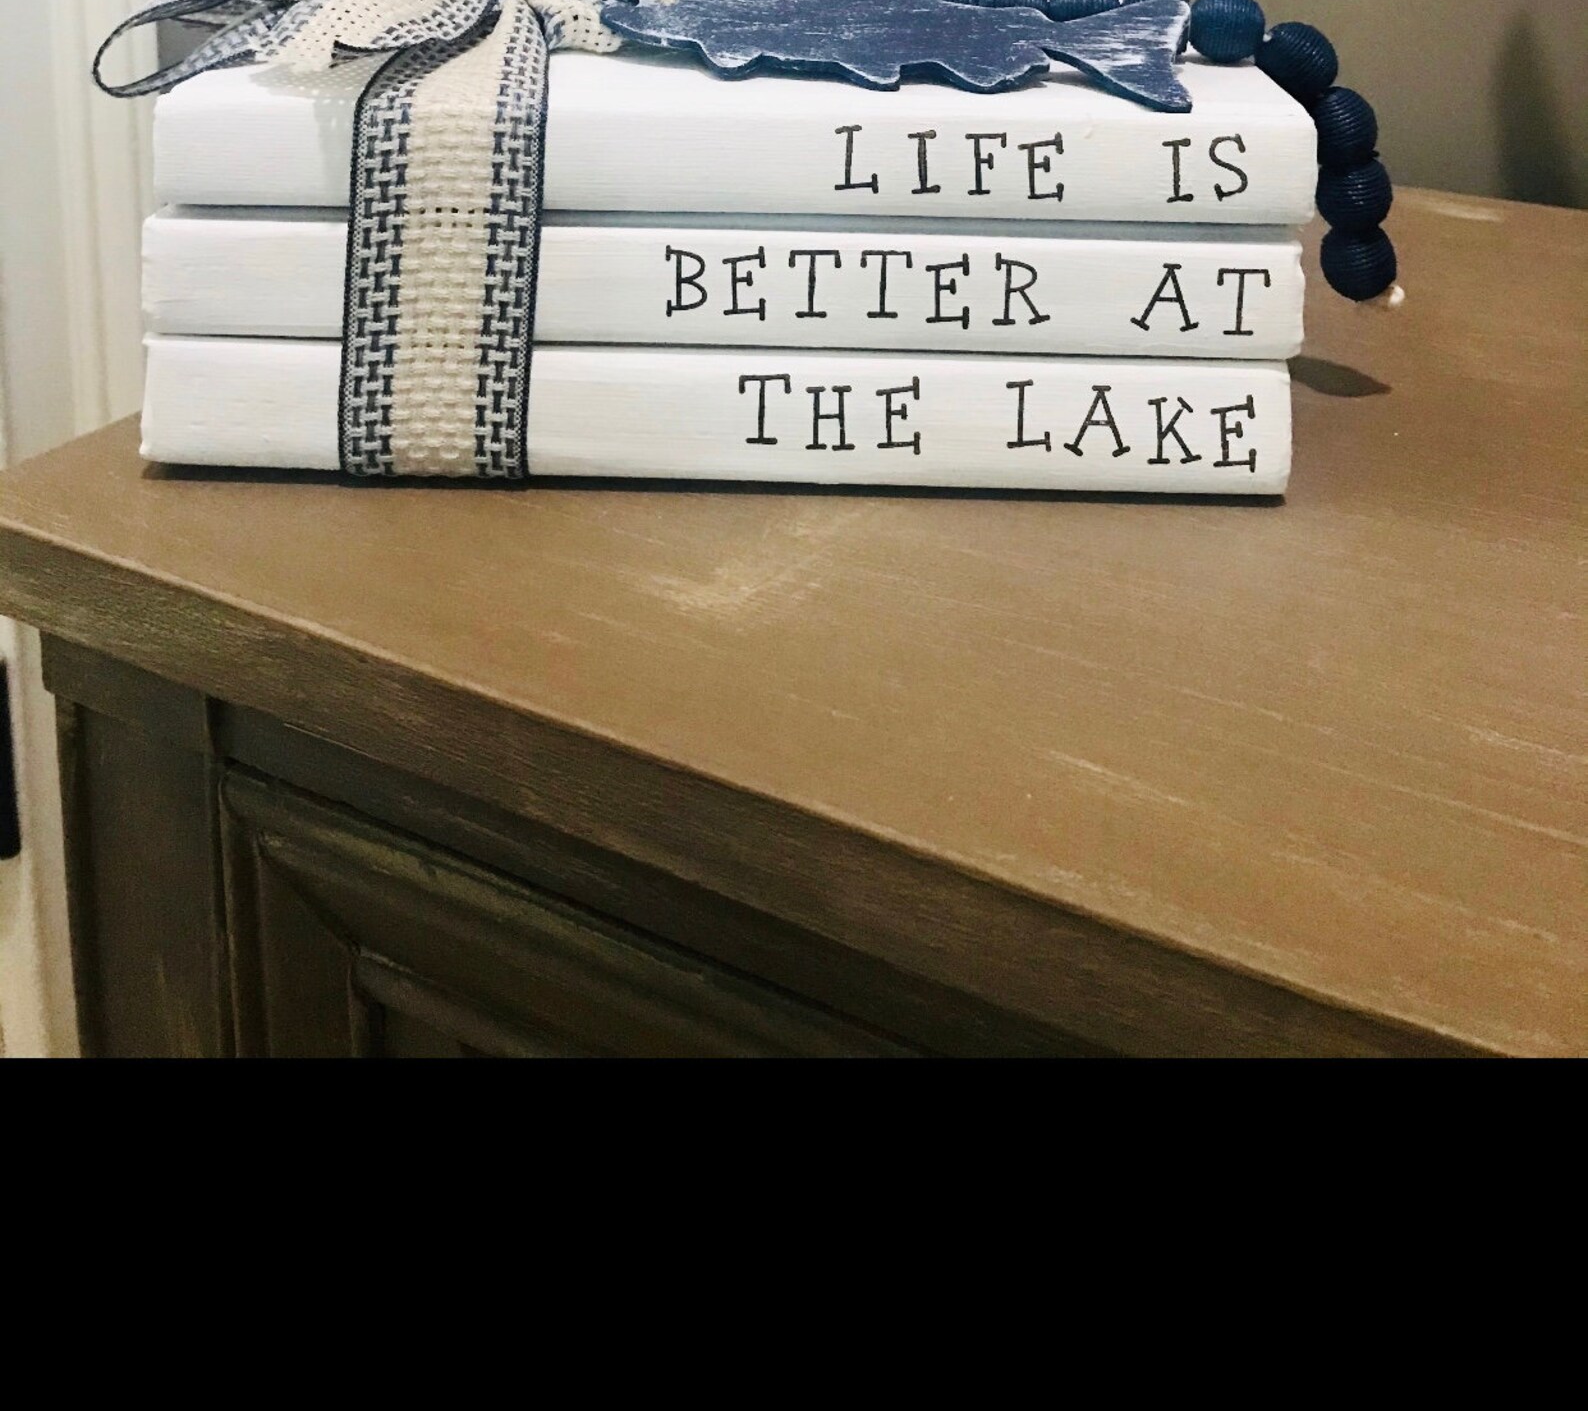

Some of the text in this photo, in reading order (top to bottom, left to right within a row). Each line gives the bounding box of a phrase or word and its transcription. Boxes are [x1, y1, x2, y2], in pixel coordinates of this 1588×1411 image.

[834, 124, 1249, 204] LIFE IS
[665, 244, 1272, 337] BETTER AT
[738, 373, 1257, 474] THE LAKE
